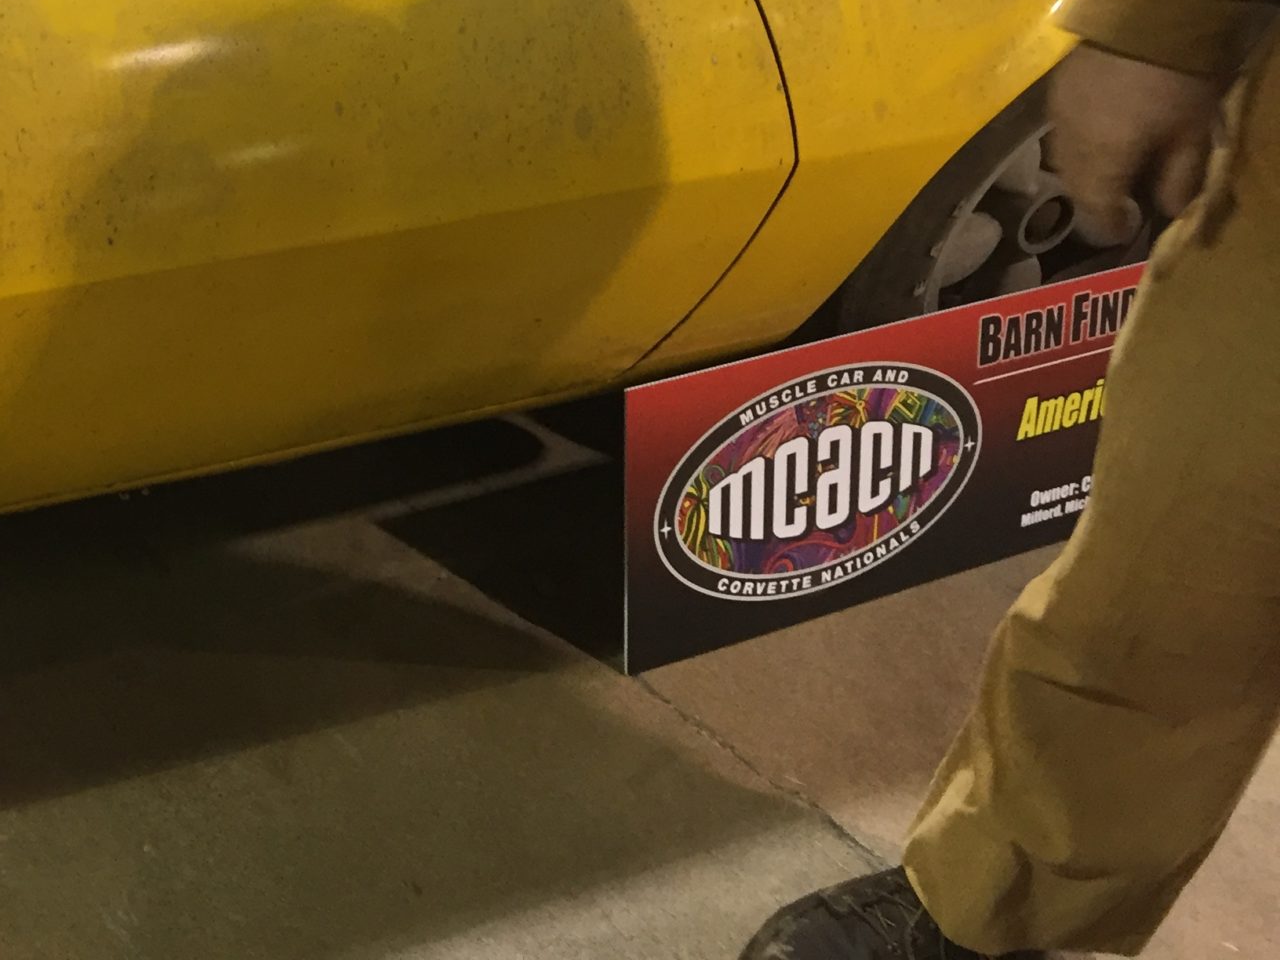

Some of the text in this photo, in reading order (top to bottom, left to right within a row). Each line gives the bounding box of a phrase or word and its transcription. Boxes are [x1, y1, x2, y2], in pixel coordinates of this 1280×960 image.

[978, 302, 1066, 367] BARN
[740, 369, 909, 425] MUSCLE CAR AND
[1030, 482, 1079, 507] Owner:
[718, 521, 920, 594] CORVETTE NATIONALS
